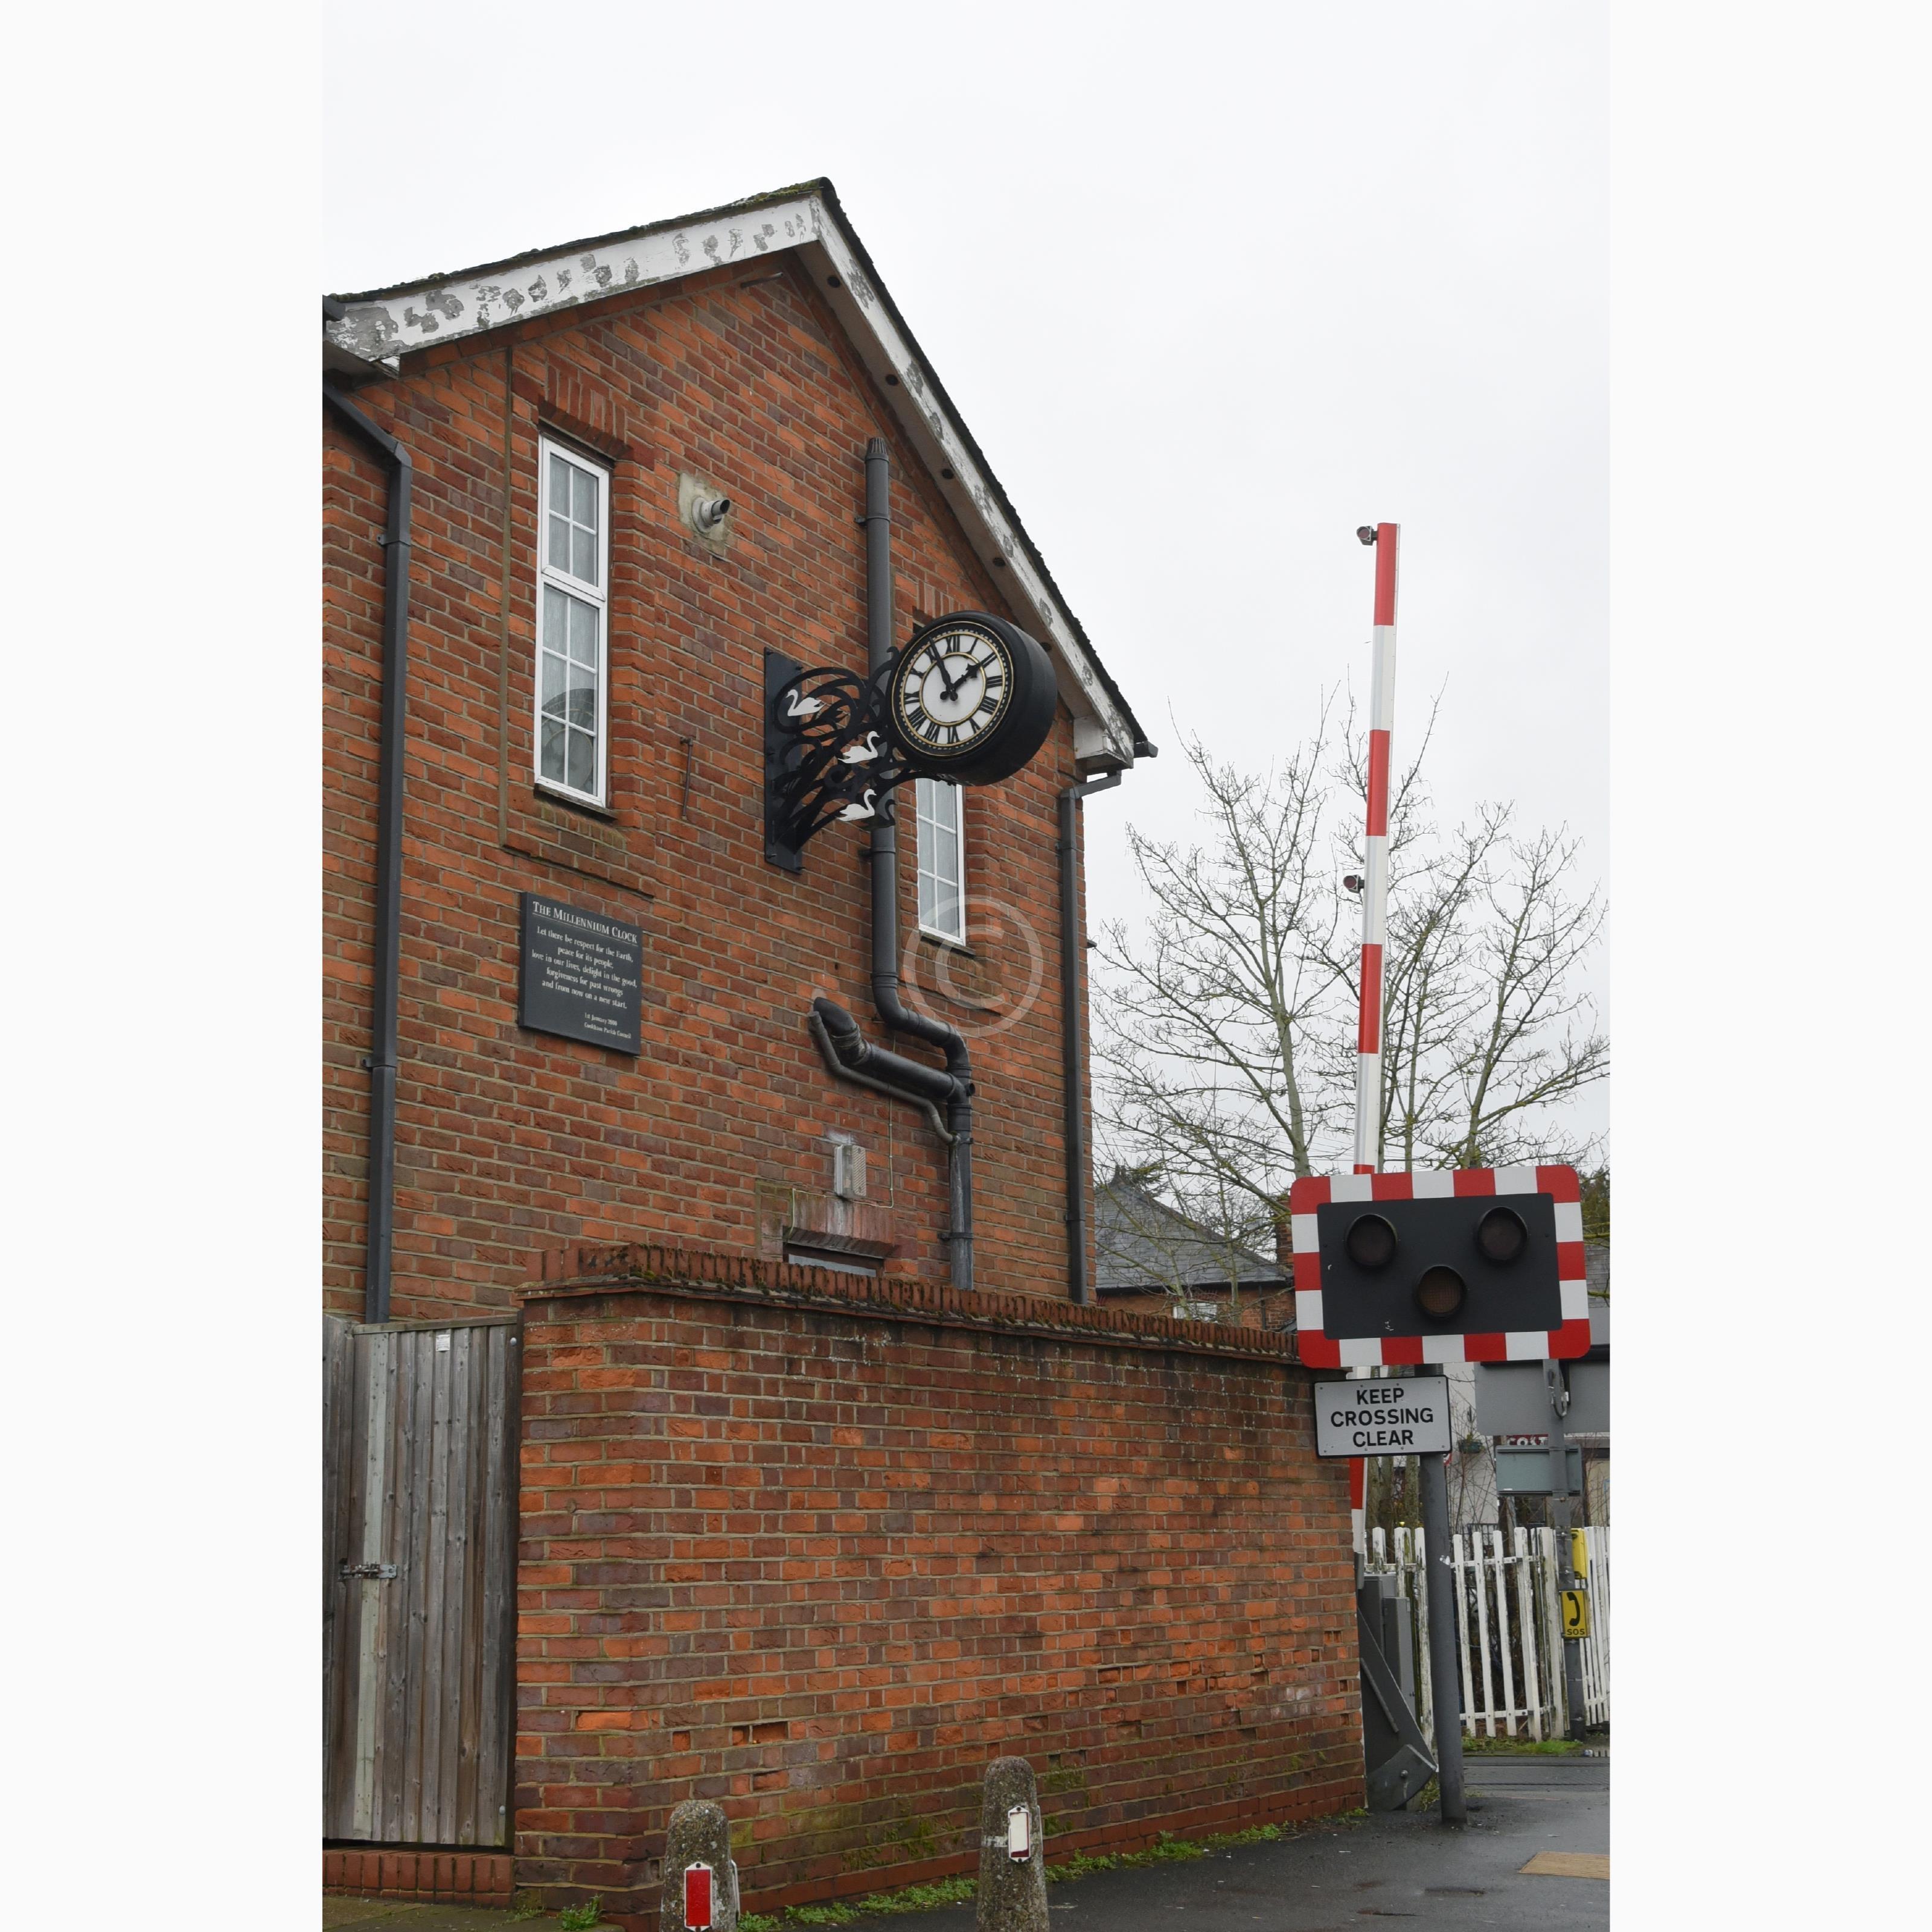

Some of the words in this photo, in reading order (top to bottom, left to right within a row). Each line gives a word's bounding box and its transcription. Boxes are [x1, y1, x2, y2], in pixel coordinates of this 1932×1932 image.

[945, 636, 961, 654] XII
[910, 667, 924, 679] X
[985, 675, 1003, 689] III
[904, 691, 920, 705] IX
[979, 696, 999, 715] IIII
[907, 706, 927, 731] VIII
[969, 717, 981, 734] V
[924, 722, 941, 744] VII
[947, 726, 961, 744] VI
[533, 901, 551, 916] THE
[553, 907, 609, 935] MILLENNIUM
[612, 926, 638, 944] CLOCK
[537, 926, 546, 936] Let
[548, 930, 563, 941] there
[565, 934, 572, 944] be
[574, 939, 595, 950] respect
[596, 944, 604, 953] for
[606, 947, 615, 956] the
[616, 950, 633, 962] Earth,
[558, 947, 574, 956] peace
[575, 950, 584, 959] for
[594, 958, 613, 969] people,
[532, 949, 544, 960] love
[545, 954, 552, 963] in
[554, 958, 565, 966] our
[566, 959, 580, 972] lives,
[583, 965, 602, 978] delight
[604, 971, 610, 979] in
[611, 973, 621, 982] the
[622, 979, 638, 988] good,
[546, 967, 578, 982] forgiveness
[580, 976, 588, 985] for
[589, 981, 601, 990] past
[603, 985, 623, 997] wrongs
[542, 980, 554, 989] and
[555, 982, 570, 993] from
[572, 988, 584, 997] now
[599, 996, 611, 1005] new
[612, 999, 627, 1009] start.
[591, 1014, 607, 1025] January
[1357, 1387, 1404, 1405] KEEP
[1330, 1407, 1433, 1427] CROSSING
[1352, 1429, 1414, 1447] CLEAR
